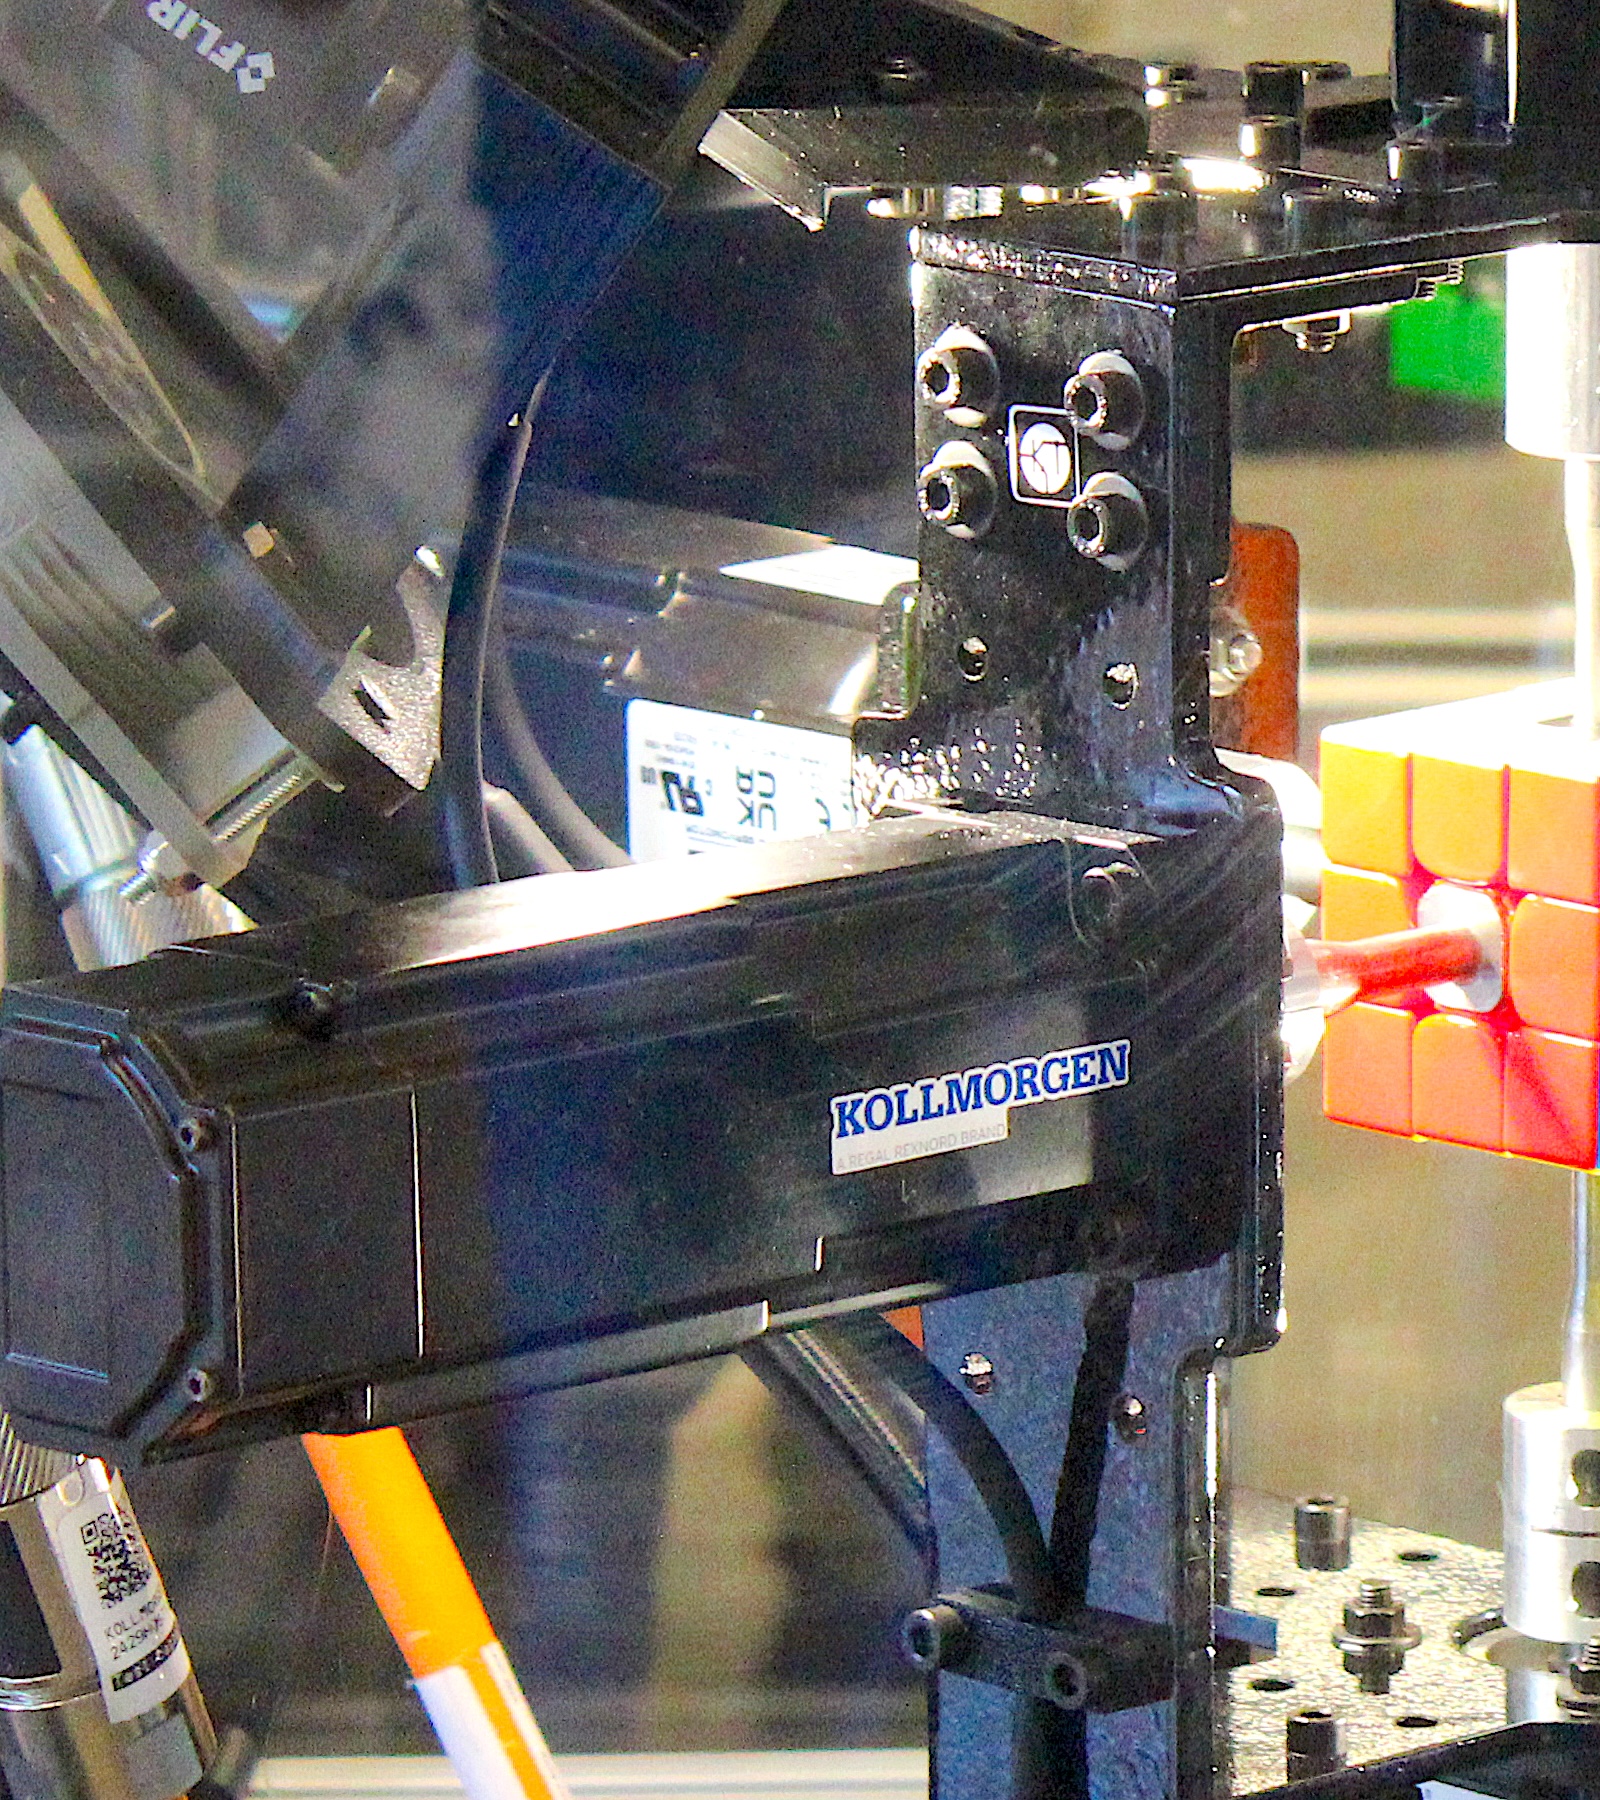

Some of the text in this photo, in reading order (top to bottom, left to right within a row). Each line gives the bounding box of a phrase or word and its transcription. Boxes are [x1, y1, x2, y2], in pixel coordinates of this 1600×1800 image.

[147, 0, 245, 73] FLIR
[737, 797, 777, 831] UK
[836, 1043, 1128, 1138] KOLLMORGEN
[837, 1123, 1006, 1169] A REGAL REXNORD BRAND
